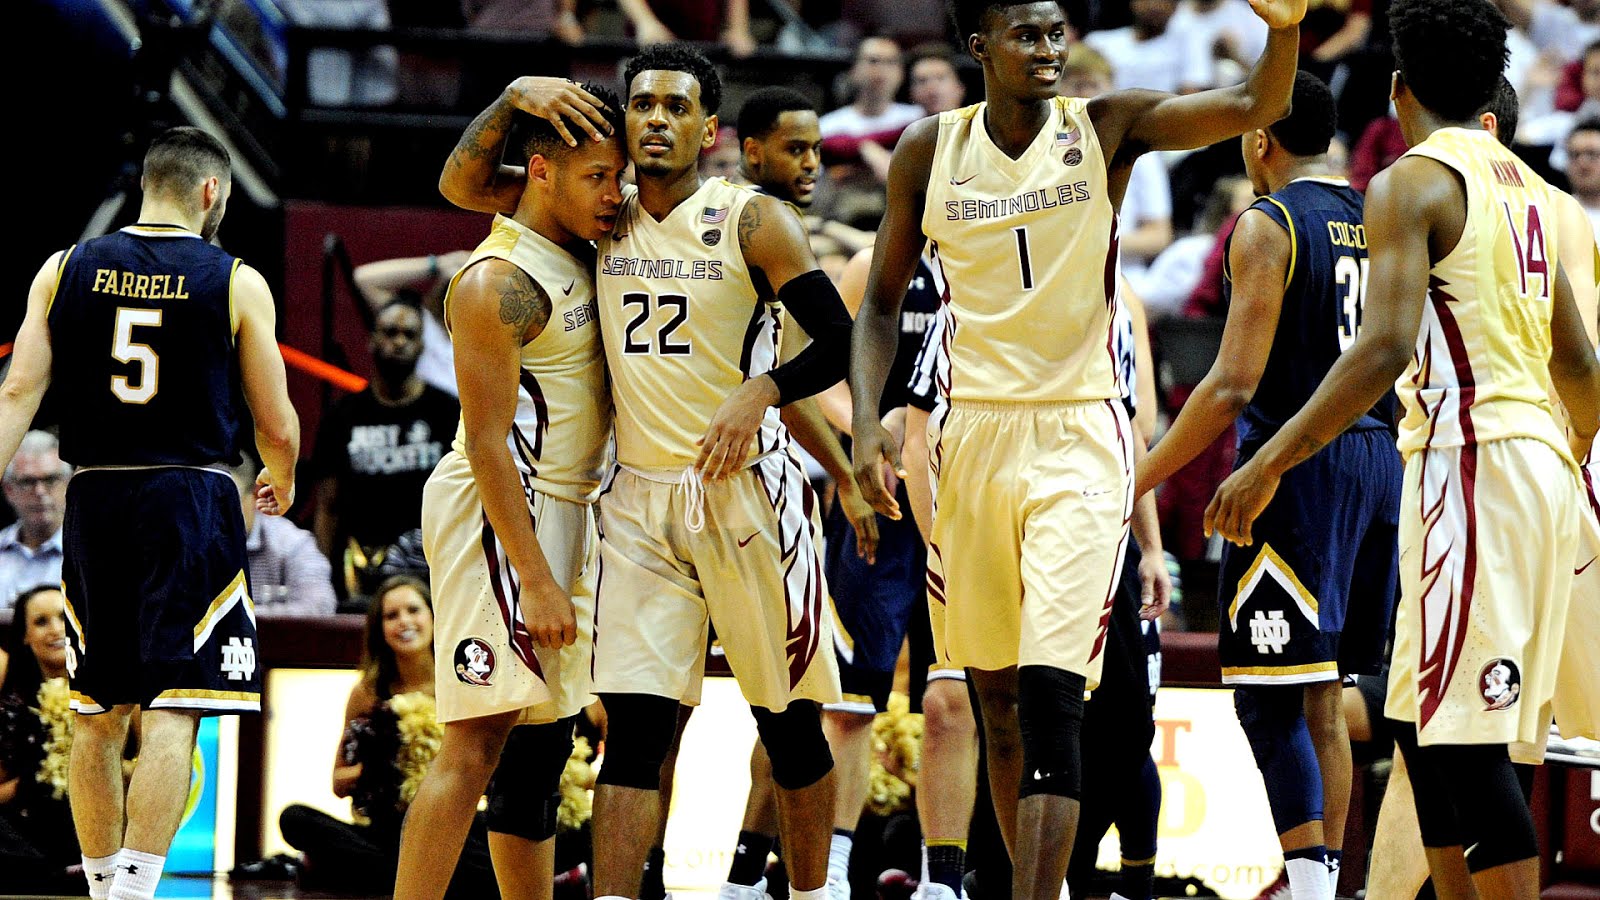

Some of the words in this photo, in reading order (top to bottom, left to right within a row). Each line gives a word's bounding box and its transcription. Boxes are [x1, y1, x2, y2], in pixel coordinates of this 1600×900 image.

[945, 180, 1091, 221] SEMINOLES
[602, 255, 724, 280] SEMINOLES
[1010, 224, 1035, 291] 1
[1504, 201, 1550, 300] 14
[92, 268, 190, 300] FARRELL
[110, 306, 163, 405] 5
[621, 291, 693, 357] 22
